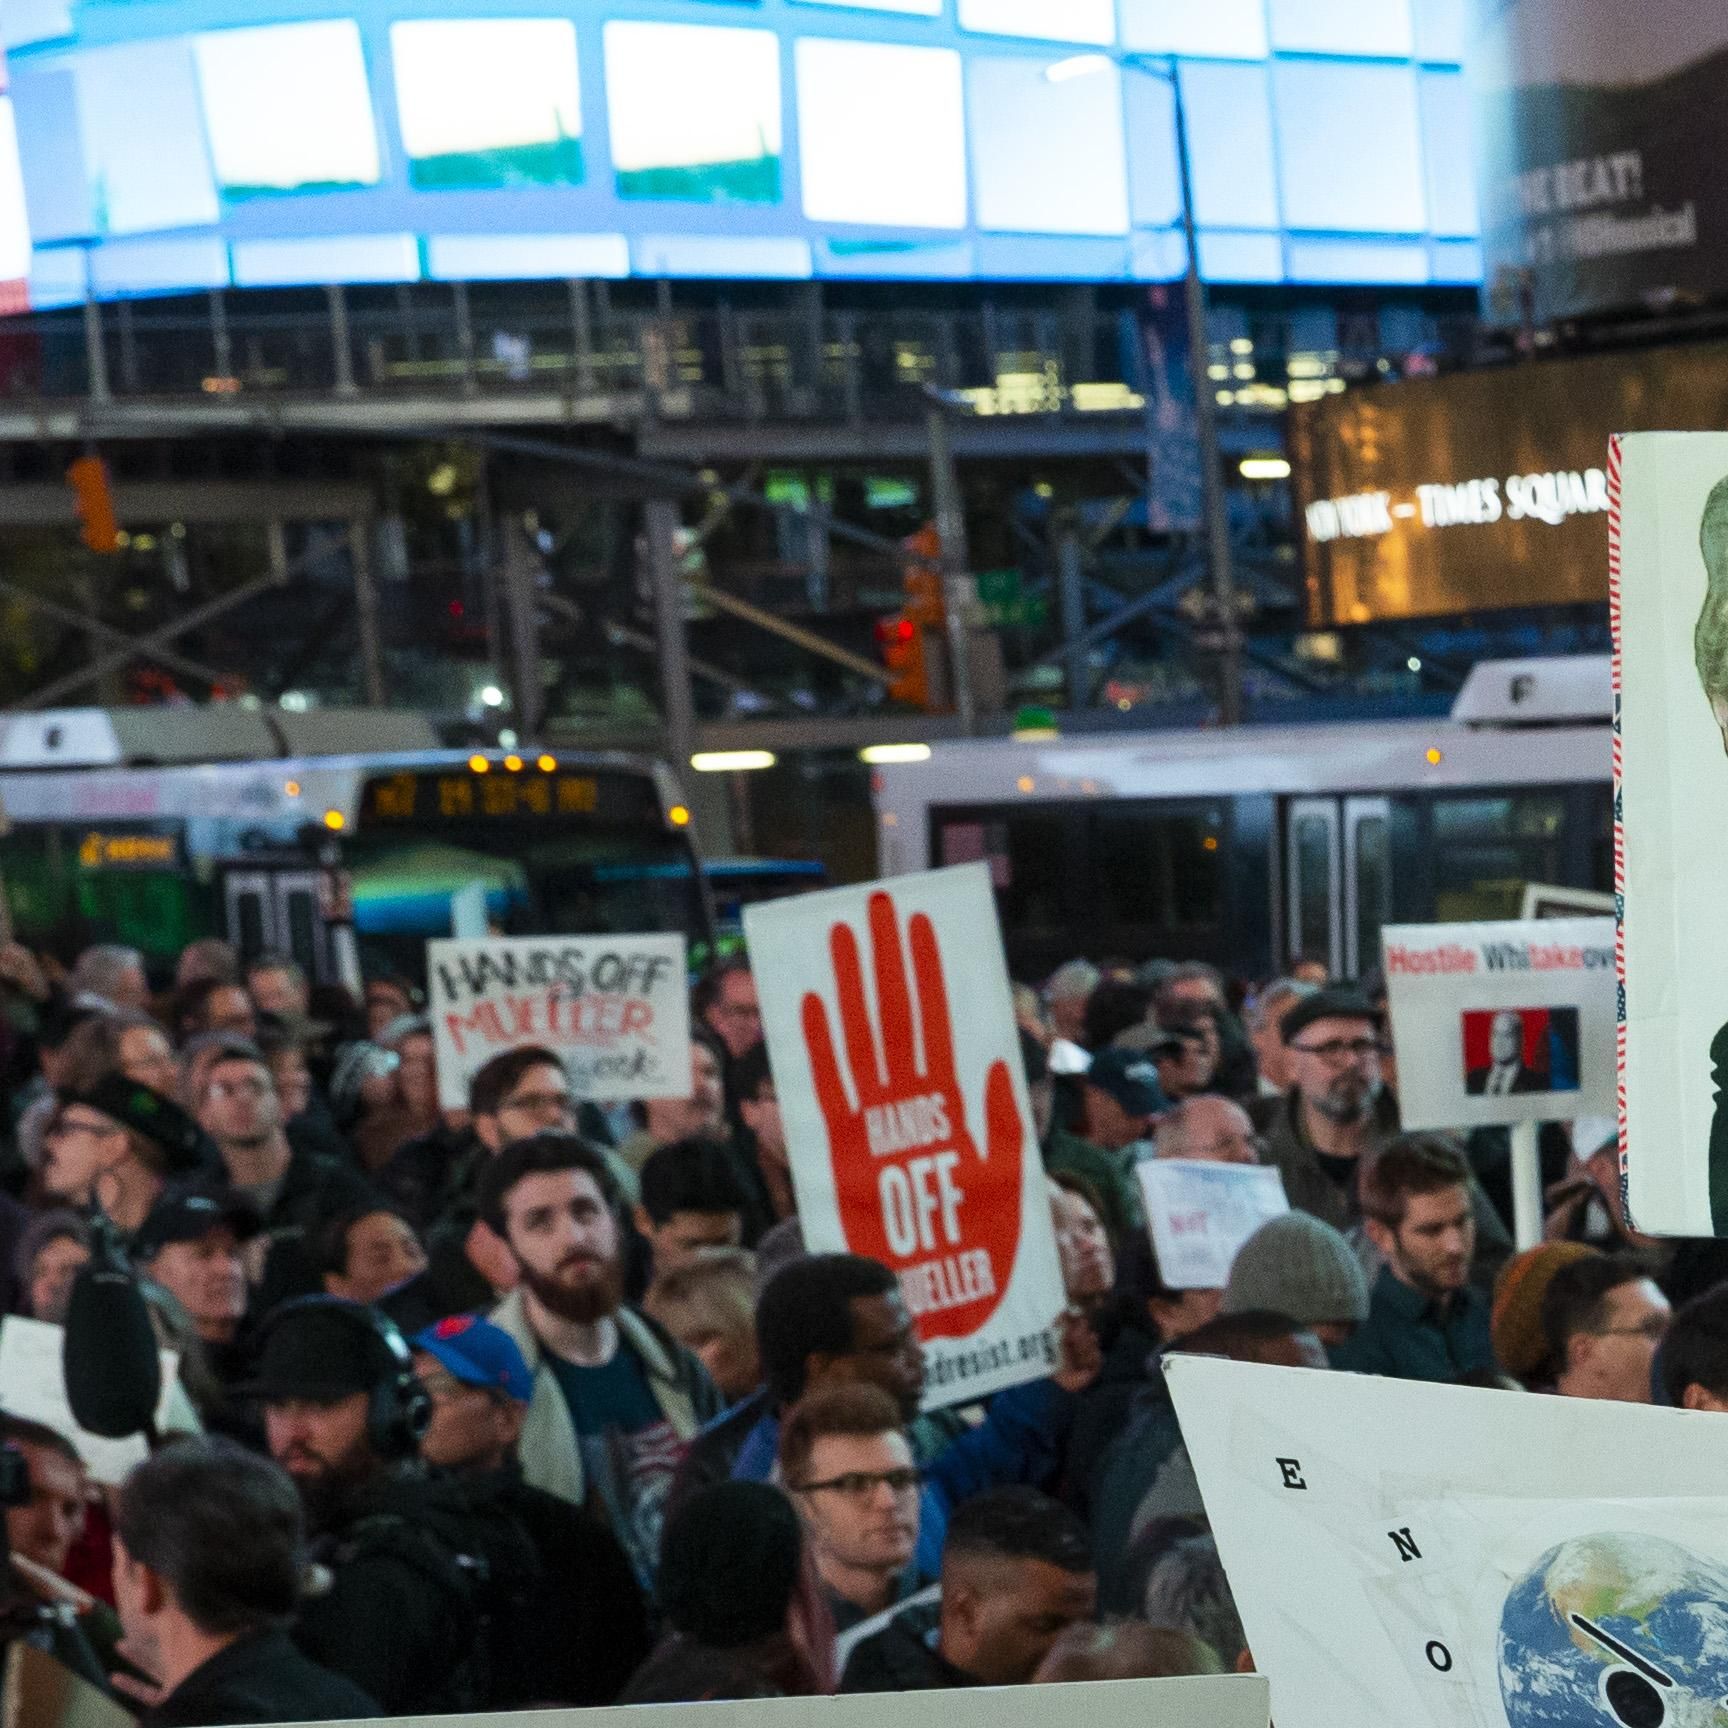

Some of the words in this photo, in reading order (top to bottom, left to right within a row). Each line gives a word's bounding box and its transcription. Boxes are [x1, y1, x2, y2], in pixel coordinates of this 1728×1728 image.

[1415, 477, 1502, 528] TIMES
[865, 1093, 953, 1157] HANDS
[877, 1151, 964, 1257] OFF
[899, 1248, 997, 1314] UELLER
